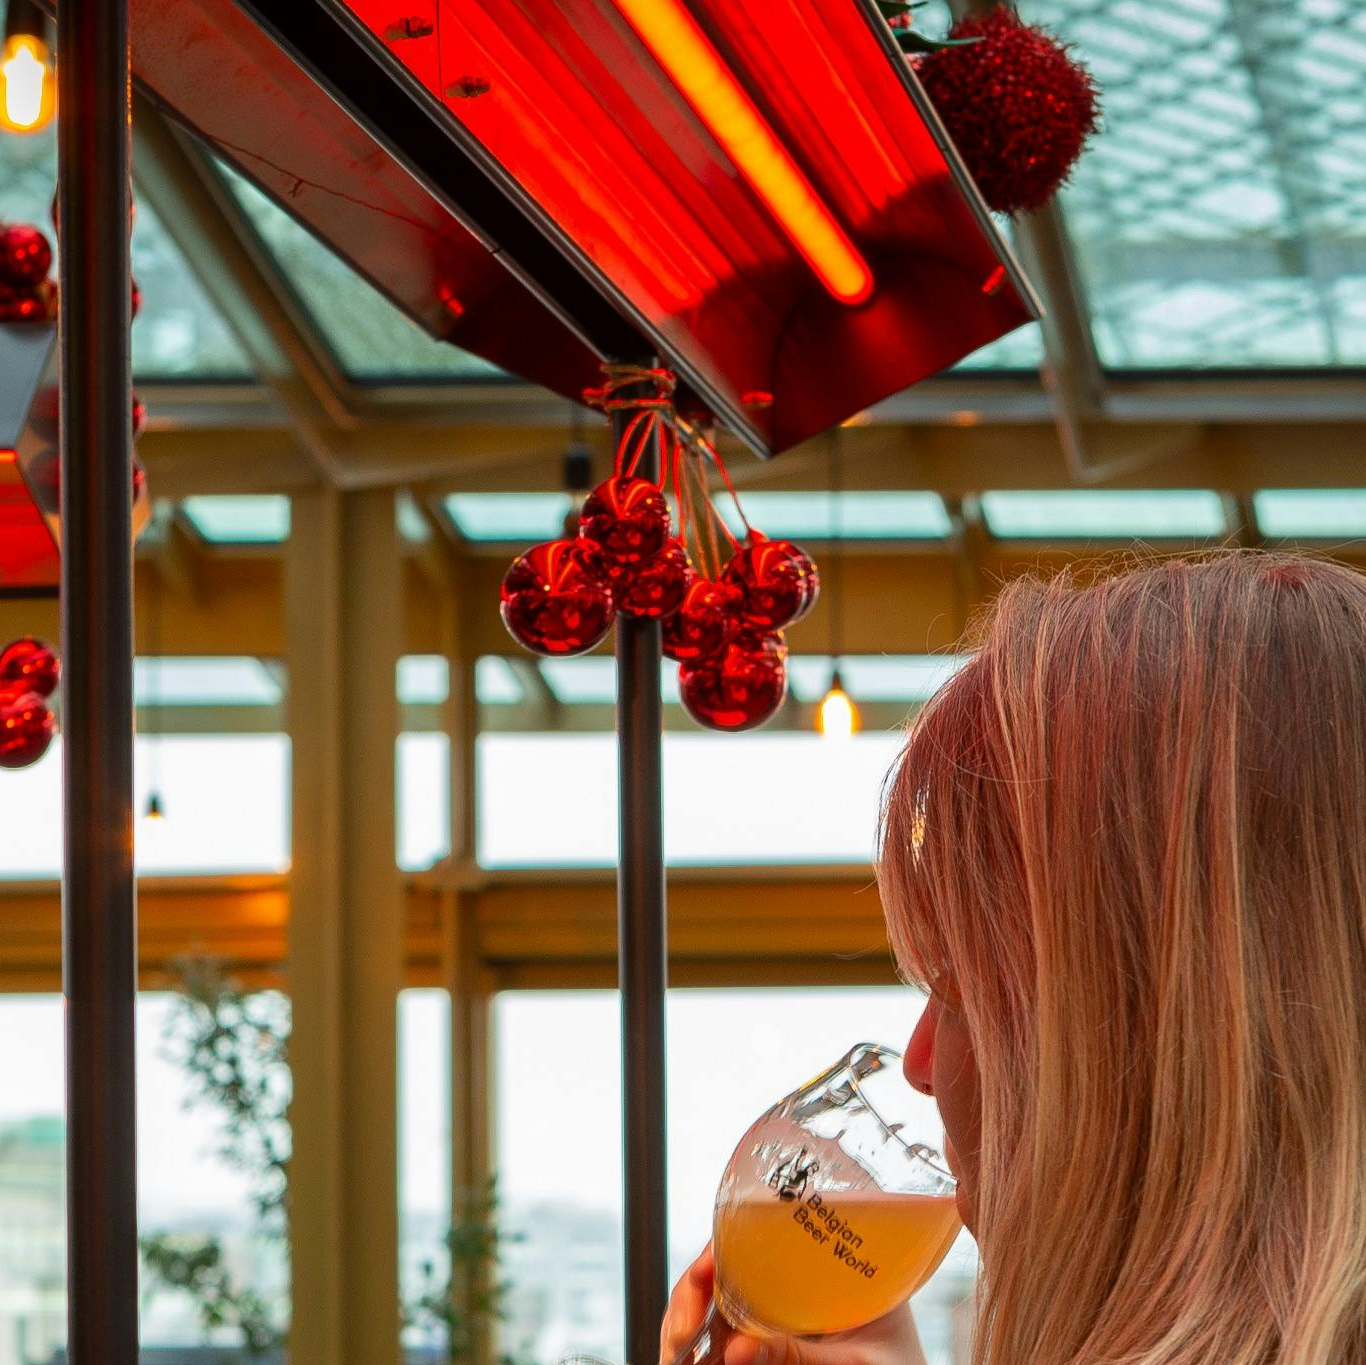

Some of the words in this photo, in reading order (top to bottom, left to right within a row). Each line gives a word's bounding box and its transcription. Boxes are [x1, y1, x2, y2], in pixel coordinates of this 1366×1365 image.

[793, 1206, 830, 1245] Beer
[833, 1240, 878, 1279] World
[806, 1193, 863, 1249] Belgian
